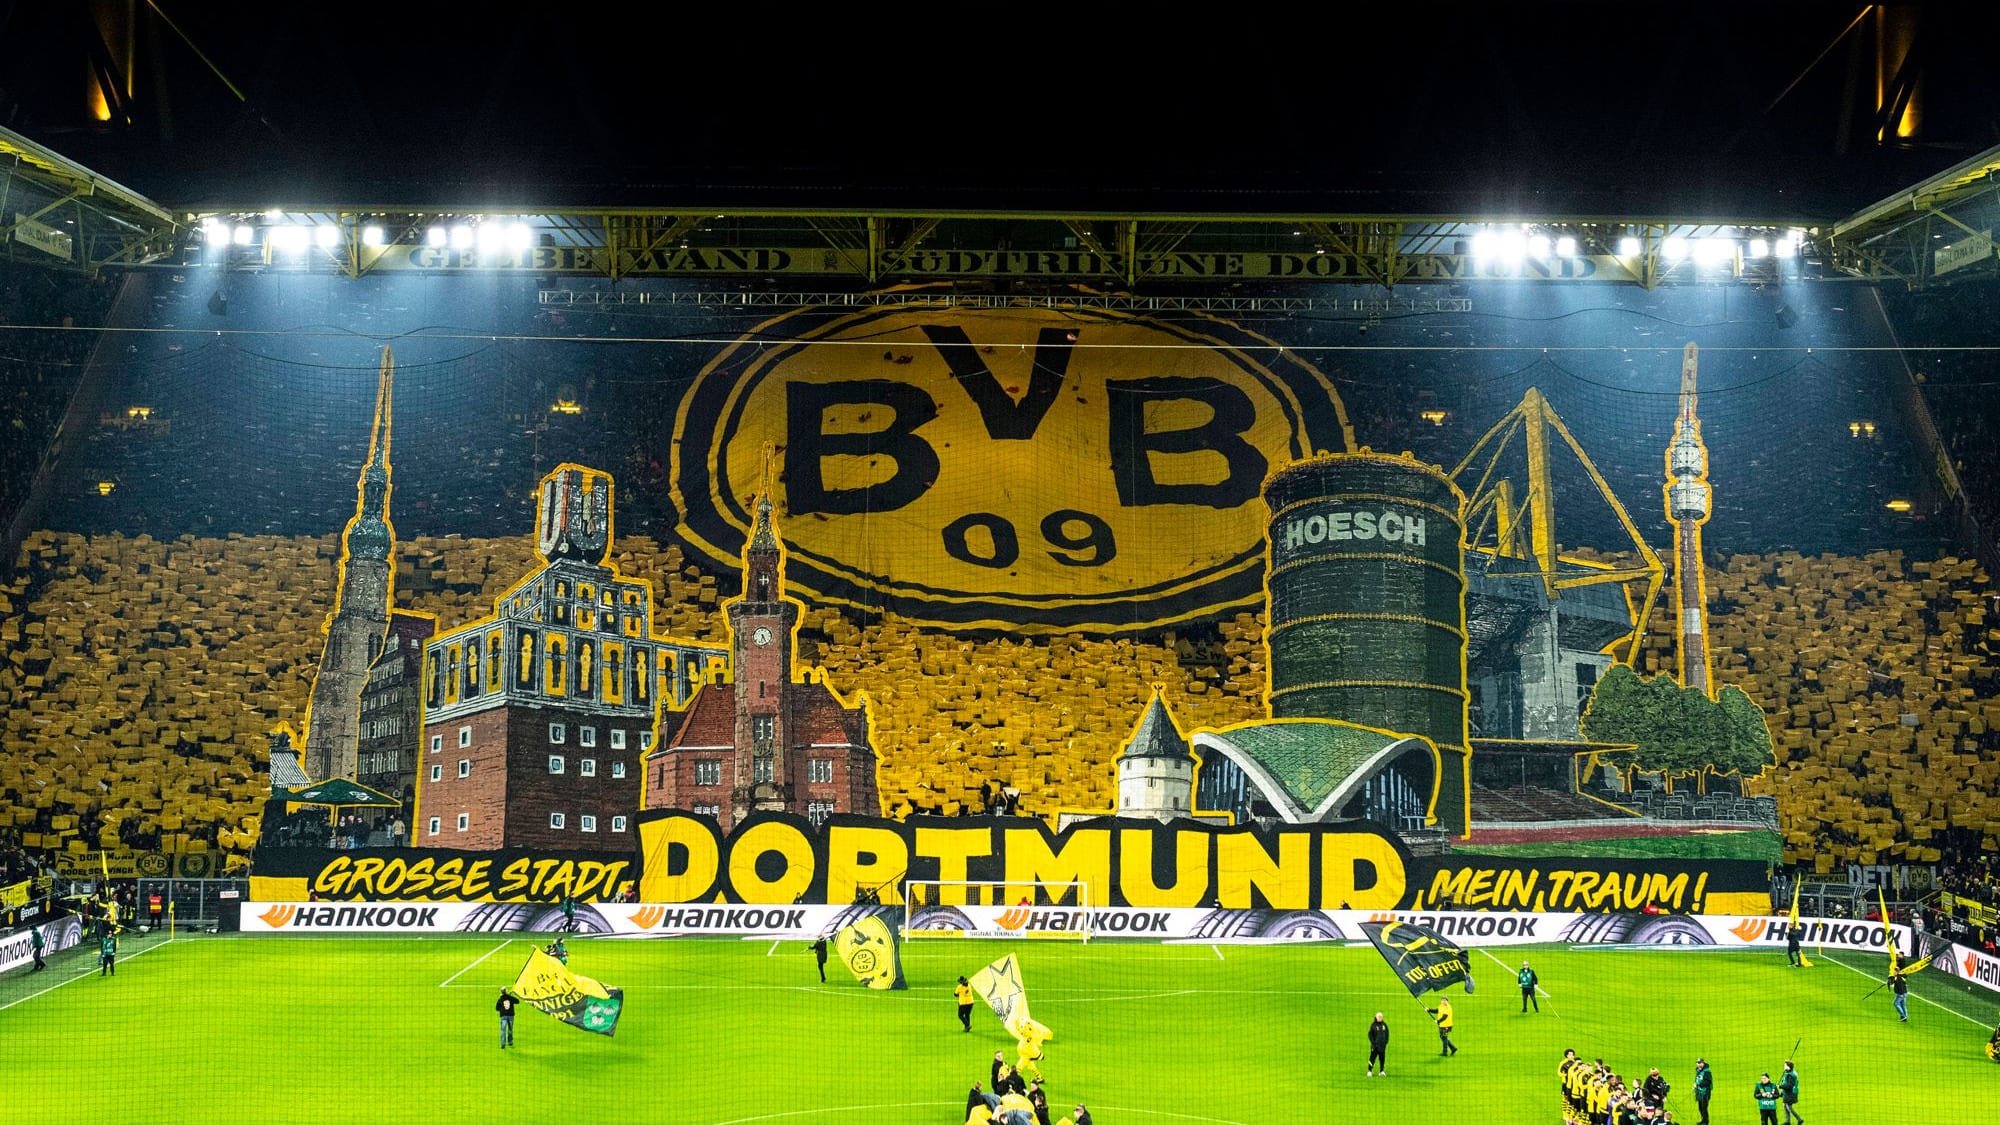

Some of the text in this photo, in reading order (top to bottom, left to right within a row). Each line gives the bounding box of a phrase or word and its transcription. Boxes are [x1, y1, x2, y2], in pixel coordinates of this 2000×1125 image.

[408, 246, 792, 272] GELBE WAND
[879, 250, 1597, 279] SÜDTRIBÜNE DORTMUND
[784, 324, 1269, 516] BVB
[942, 508, 1117, 569] 09
[1285, 510, 1426, 551] HOESCH
[79, 852, 135, 862] DORMUND
[314, 855, 493, 896] GROSSE
[639, 816, 1407, 911] DORTMUND
[1427, 866, 1709, 914] MEIN TRAUM!
